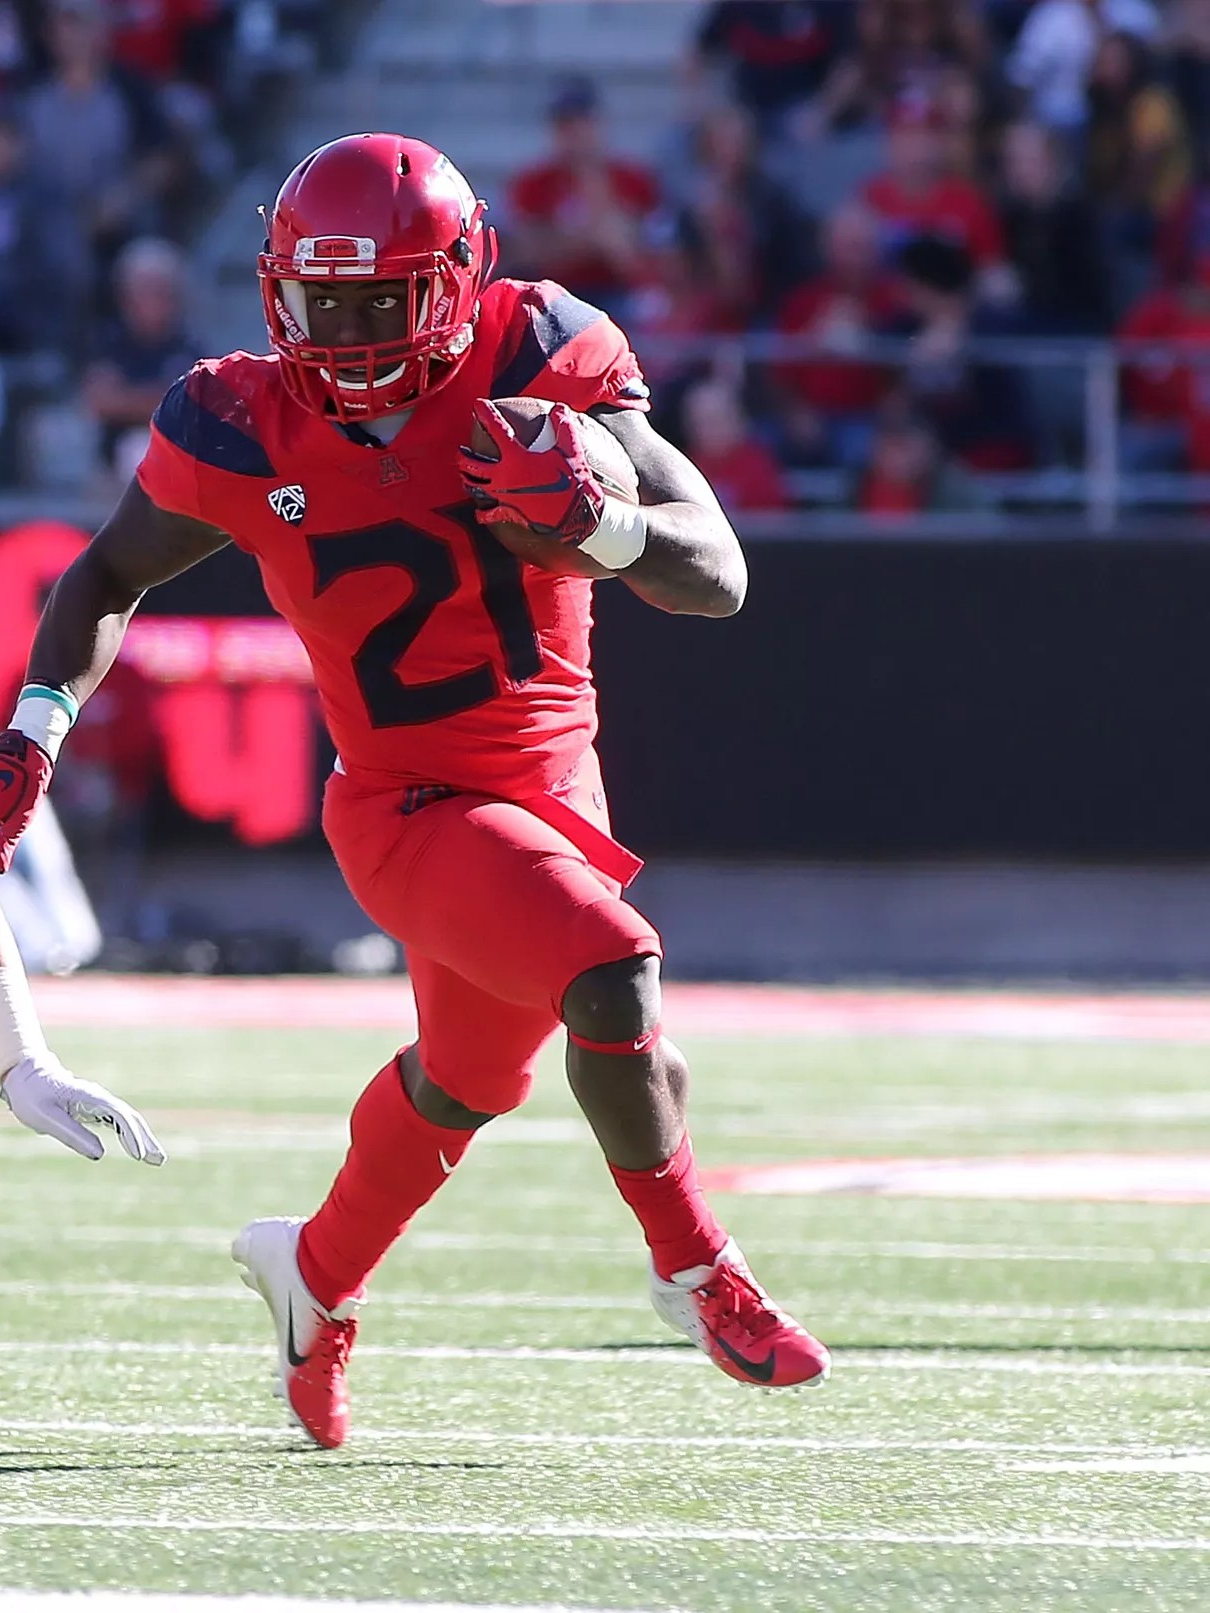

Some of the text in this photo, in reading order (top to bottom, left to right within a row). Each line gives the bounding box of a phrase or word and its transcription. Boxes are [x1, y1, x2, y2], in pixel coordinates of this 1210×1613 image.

[267, 484, 306, 515] PAC
[281, 503, 303, 522] 12
[309, 503, 543, 728] 21
